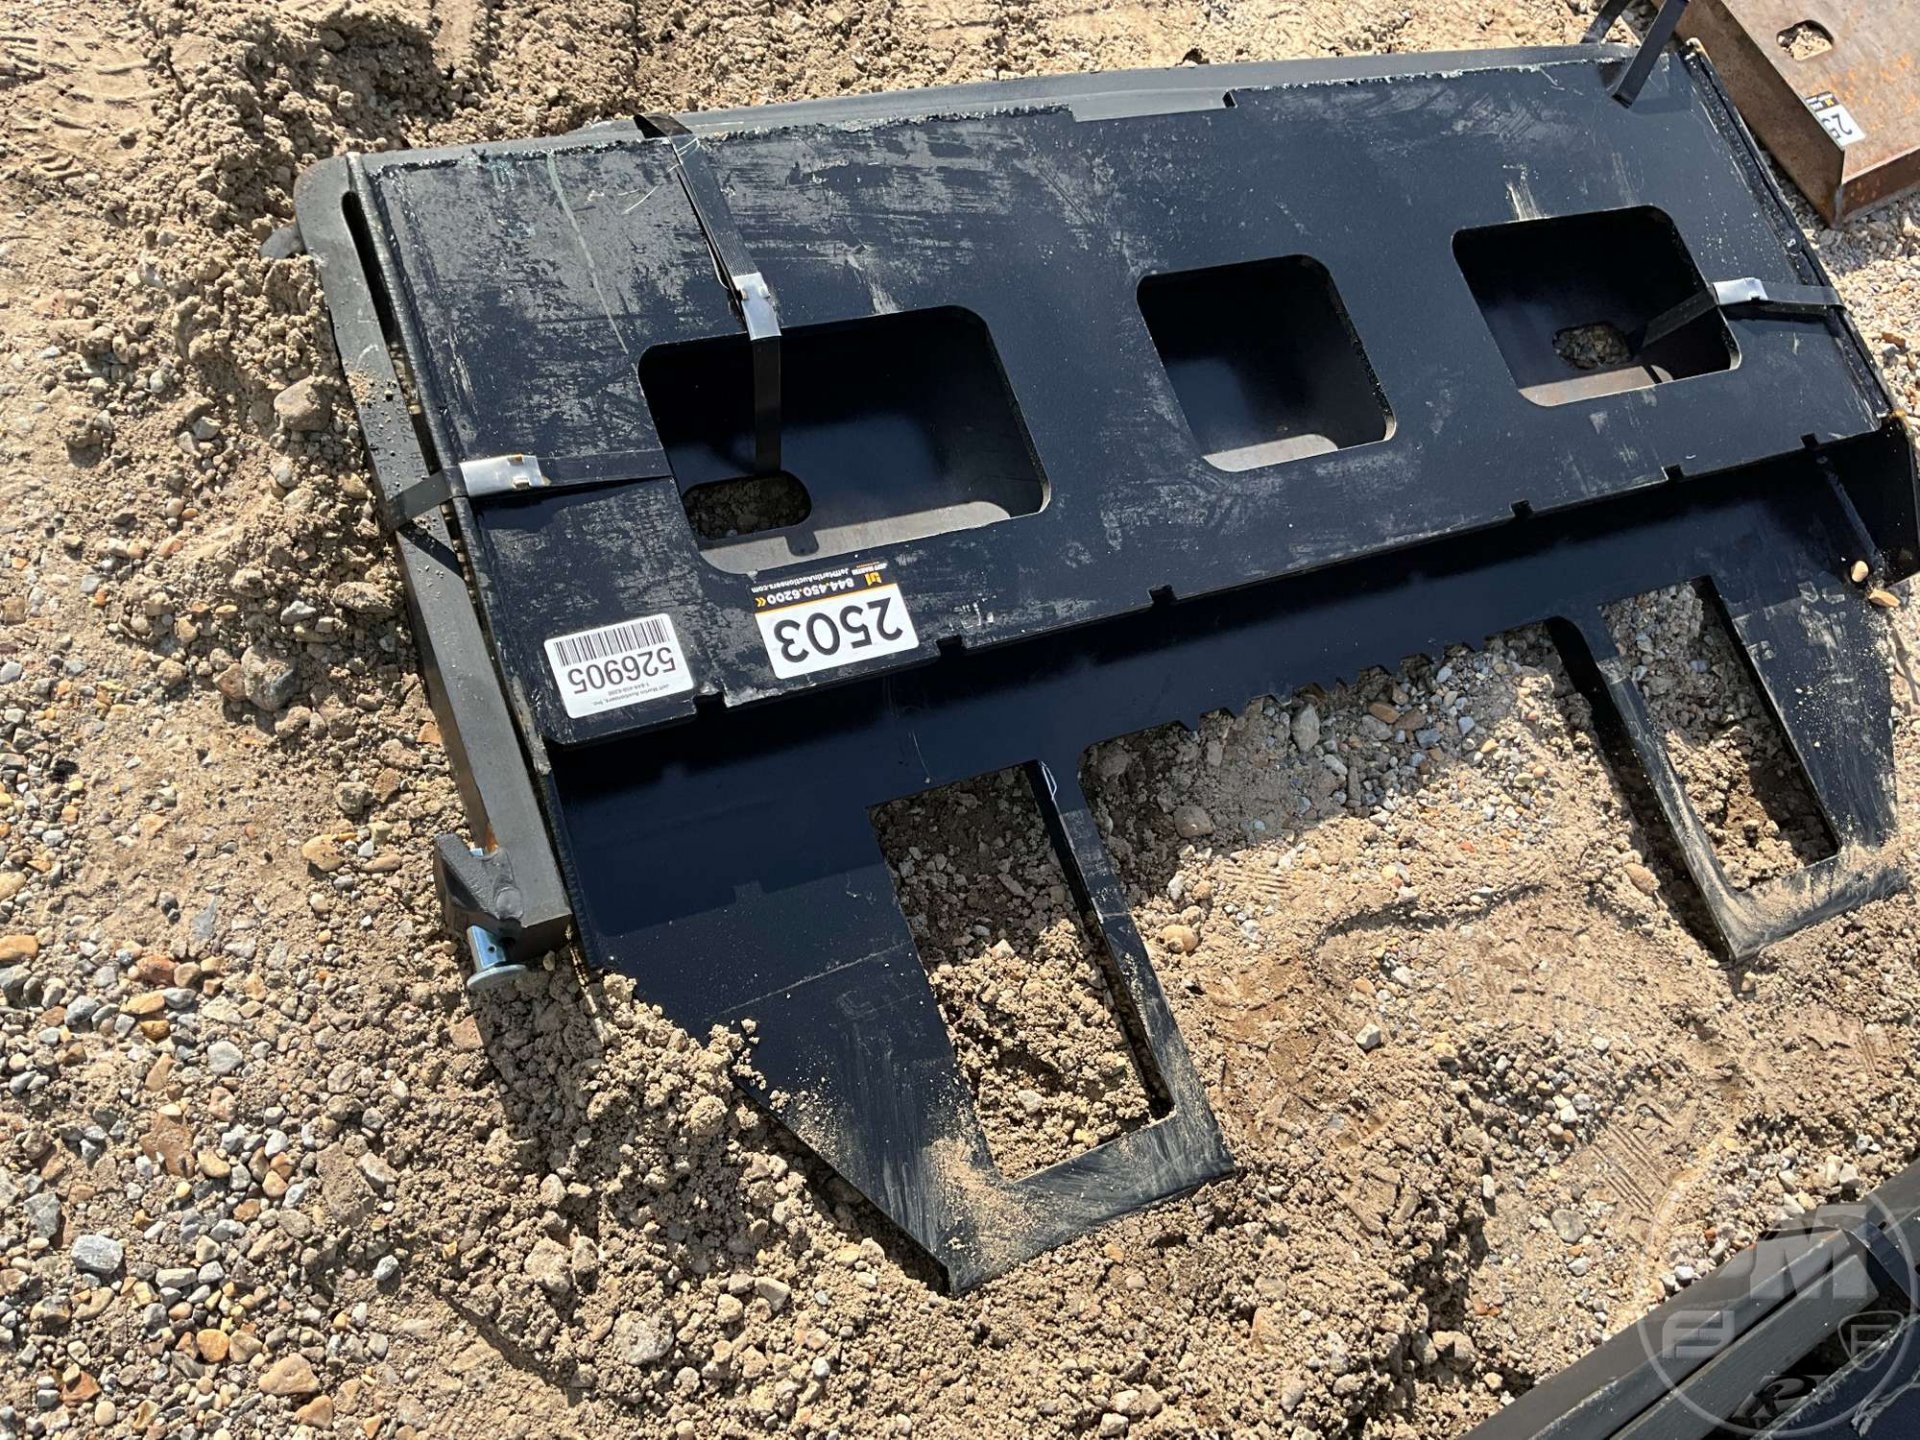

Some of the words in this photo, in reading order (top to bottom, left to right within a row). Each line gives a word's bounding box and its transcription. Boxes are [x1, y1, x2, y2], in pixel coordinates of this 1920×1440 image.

[767, 578, 854, 604] 844.450.6200
[774, 597, 903, 663] 2503
[567, 647, 676, 694] 526905
